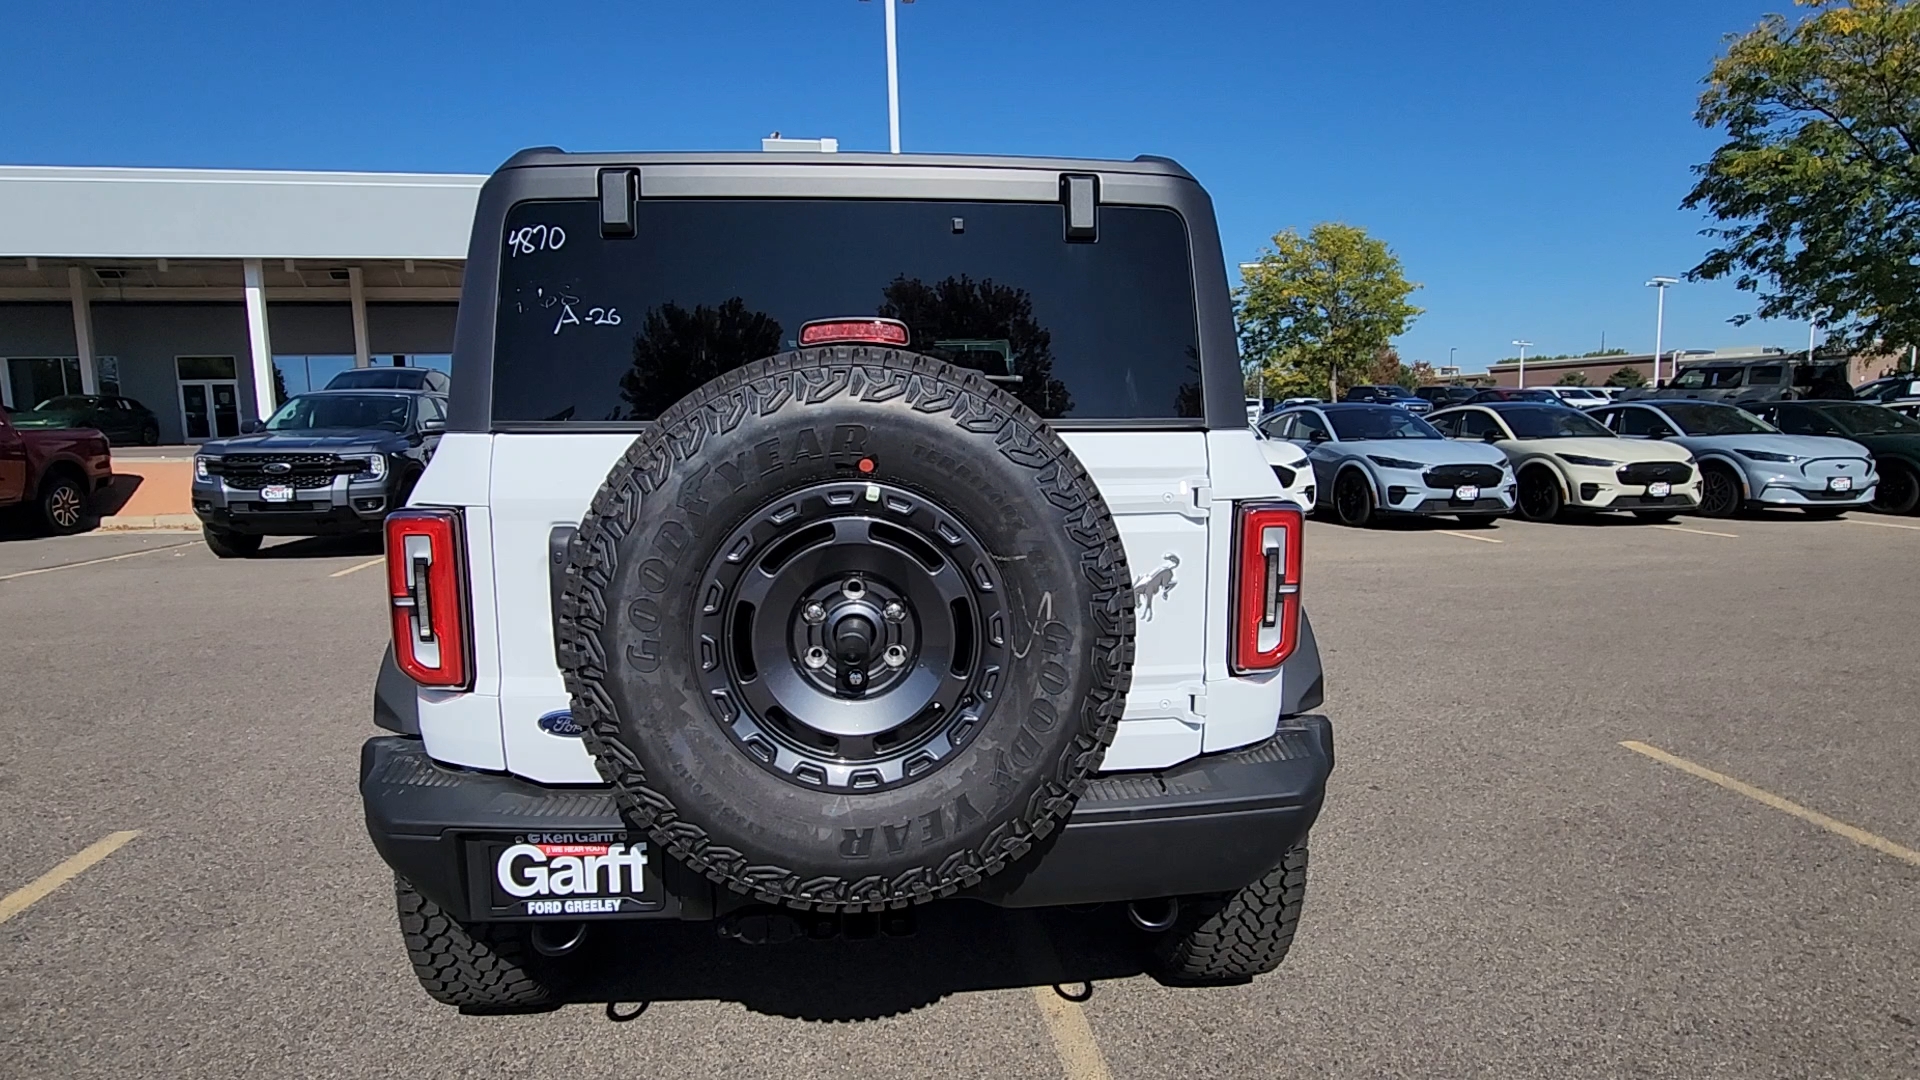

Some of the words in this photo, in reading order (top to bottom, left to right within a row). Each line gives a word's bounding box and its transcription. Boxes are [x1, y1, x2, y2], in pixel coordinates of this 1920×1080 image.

[508, 225, 566, 257] 4870
[553, 716, 584, 732] For
[496, 842, 648, 898] Garff
[528, 901, 562, 915] FORD
[564, 899, 621, 914] GREELEY
